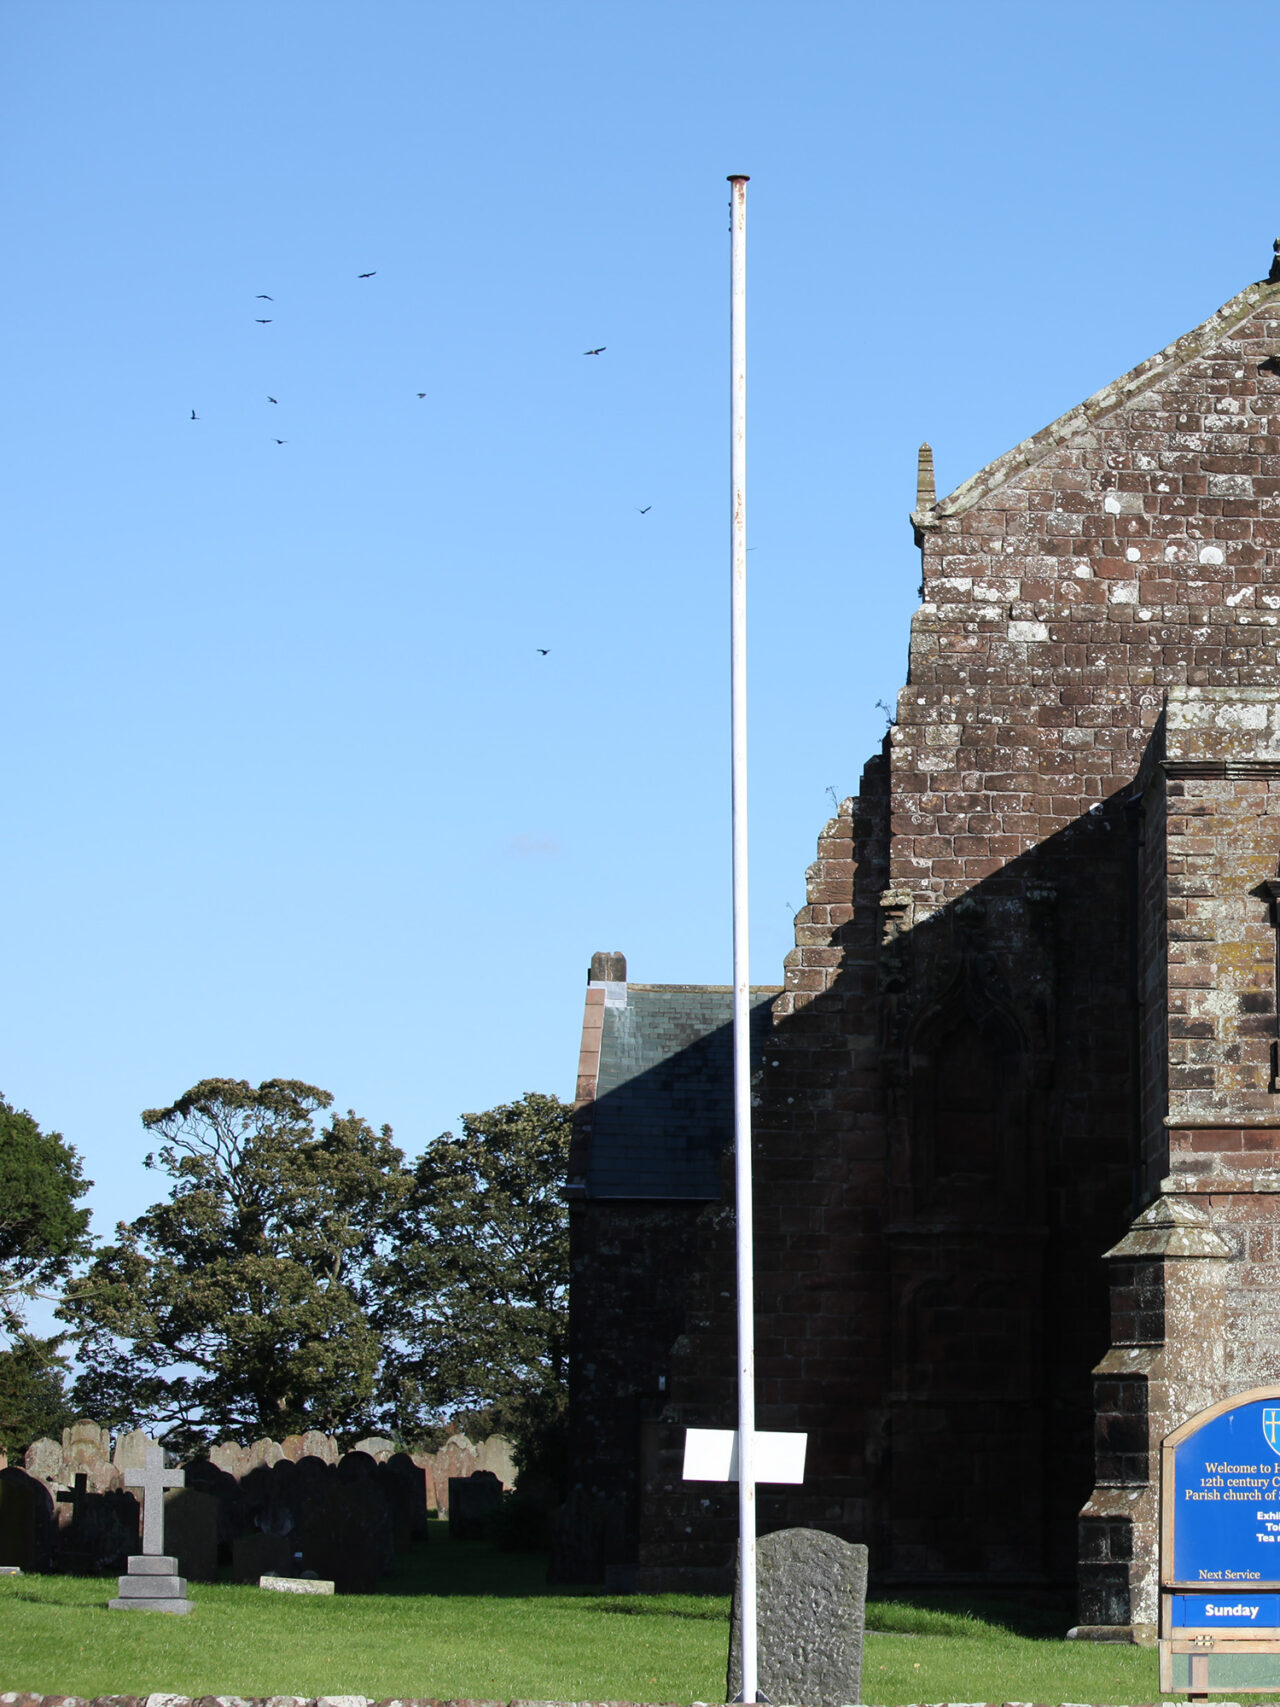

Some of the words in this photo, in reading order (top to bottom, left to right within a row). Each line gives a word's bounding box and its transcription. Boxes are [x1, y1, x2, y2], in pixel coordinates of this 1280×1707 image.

[1205, 1462, 1257, 1474] Welcome
[1260, 1464, 1272, 1474] to
[1200, 1475, 1224, 1487] 12th
[1227, 1477, 1270, 1490] century
[1185, 1489, 1221, 1501] Parish
[1223, 1489, 1262, 1501] church
[1264, 1489, 1277, 1501] of
[1256, 1533, 1275, 1543] Tea
[1198, 1570, 1222, 1580] Next
[1225, 1569, 1261, 1580] Service
[1205, 1604, 1260, 1619] Sunday
